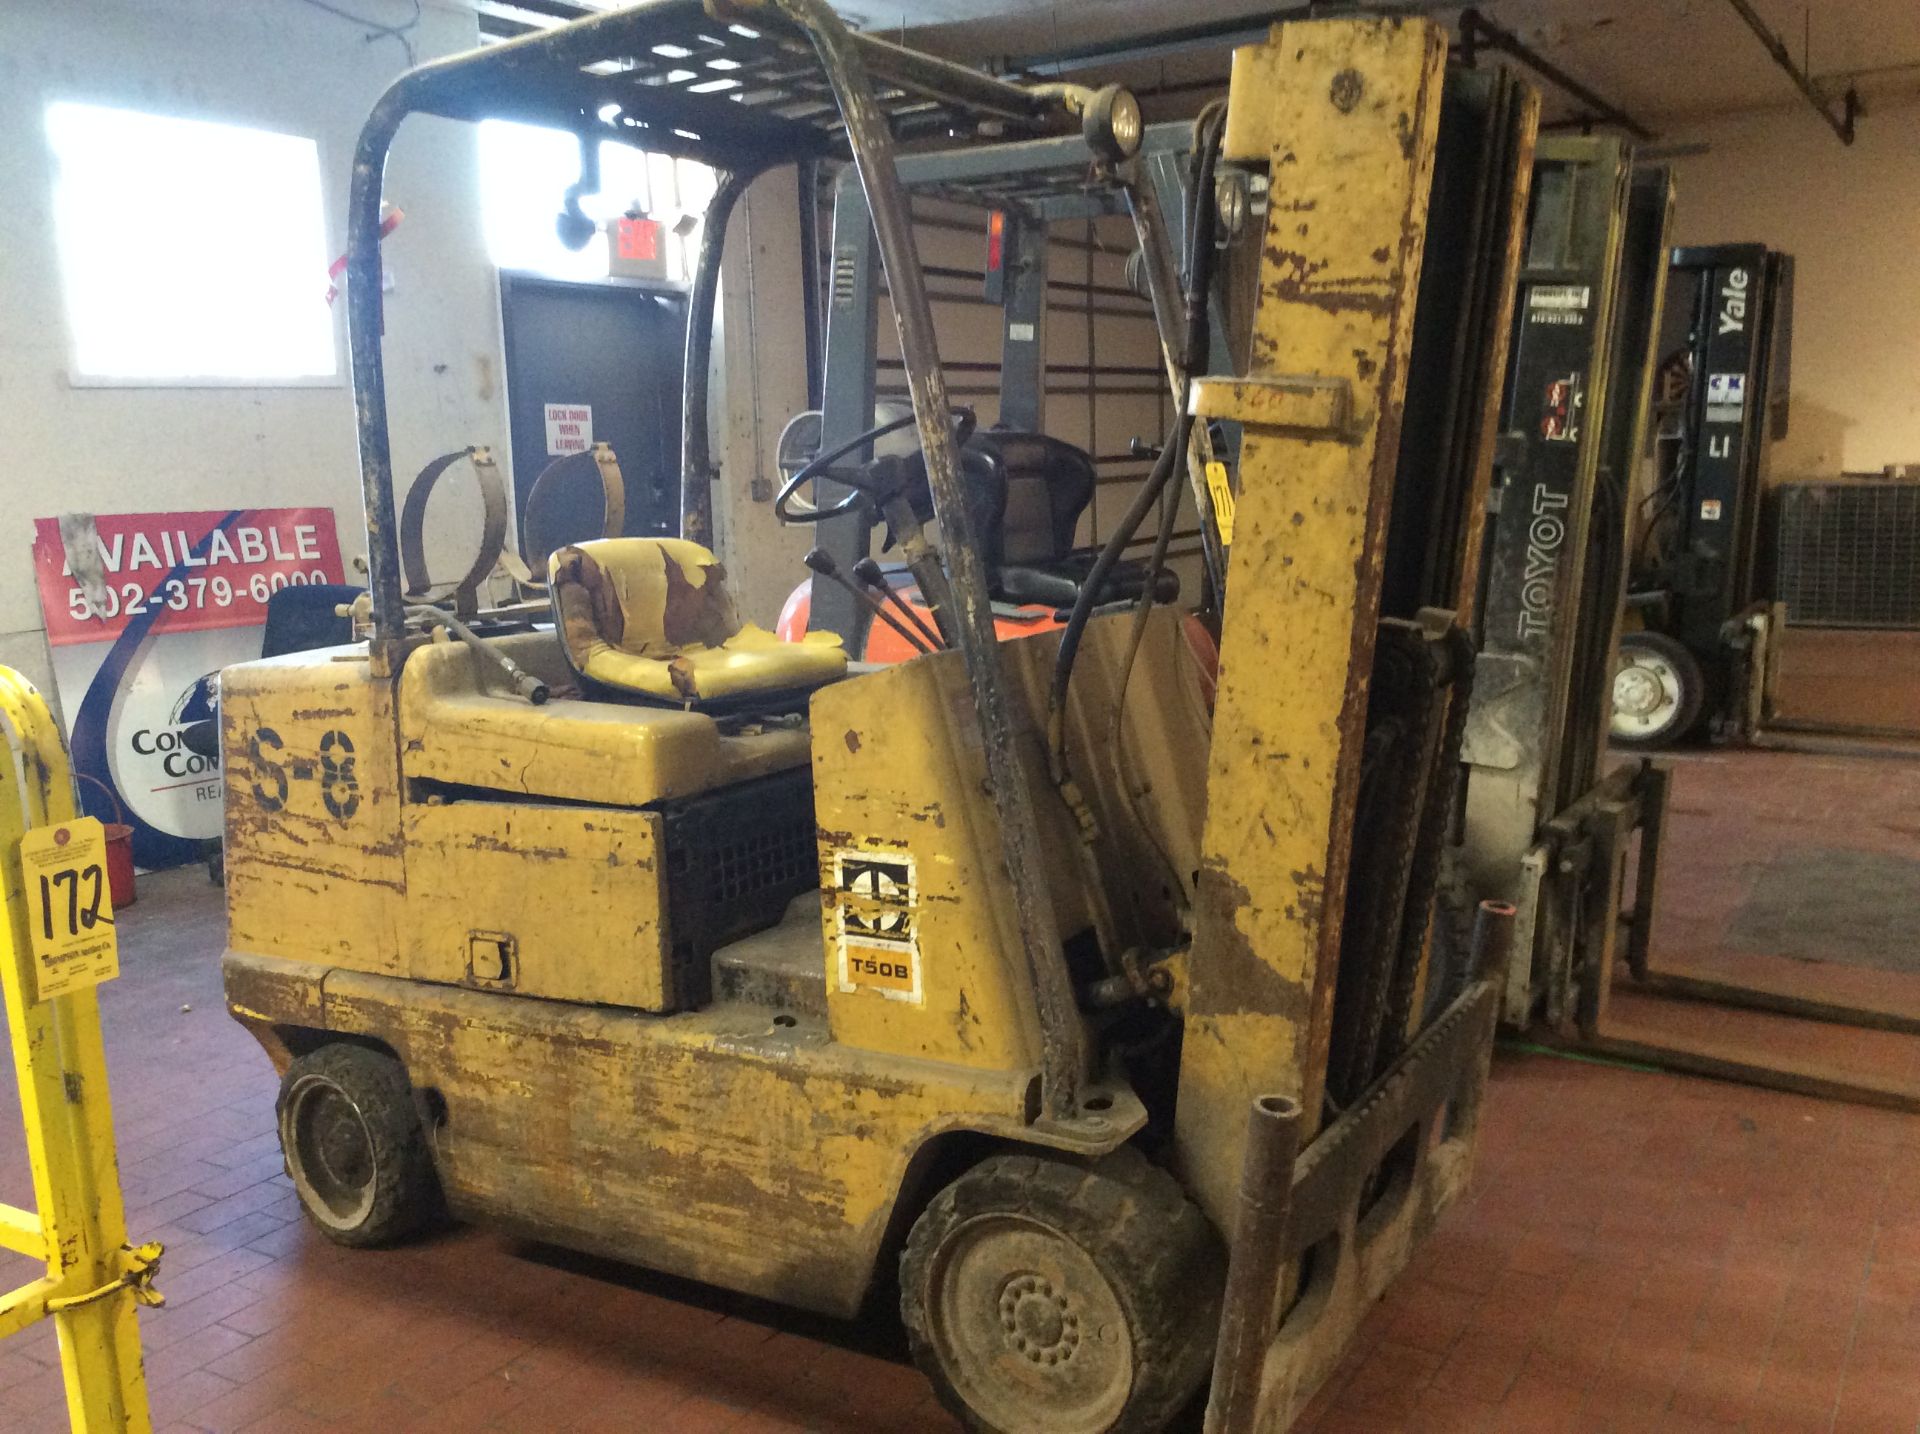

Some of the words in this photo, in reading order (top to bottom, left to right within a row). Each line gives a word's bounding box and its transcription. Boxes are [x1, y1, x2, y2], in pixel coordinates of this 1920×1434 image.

[1719, 267, 1748, 335] Yale
[548, 409, 567, 421] LOCK
[569, 410, 588, 422] DOOR
[558, 424, 580, 436] WHEN
[62, 524, 322, 577] VAILABLE
[39, 863, 115, 940] 172
[851, 957, 908, 979] T50B
